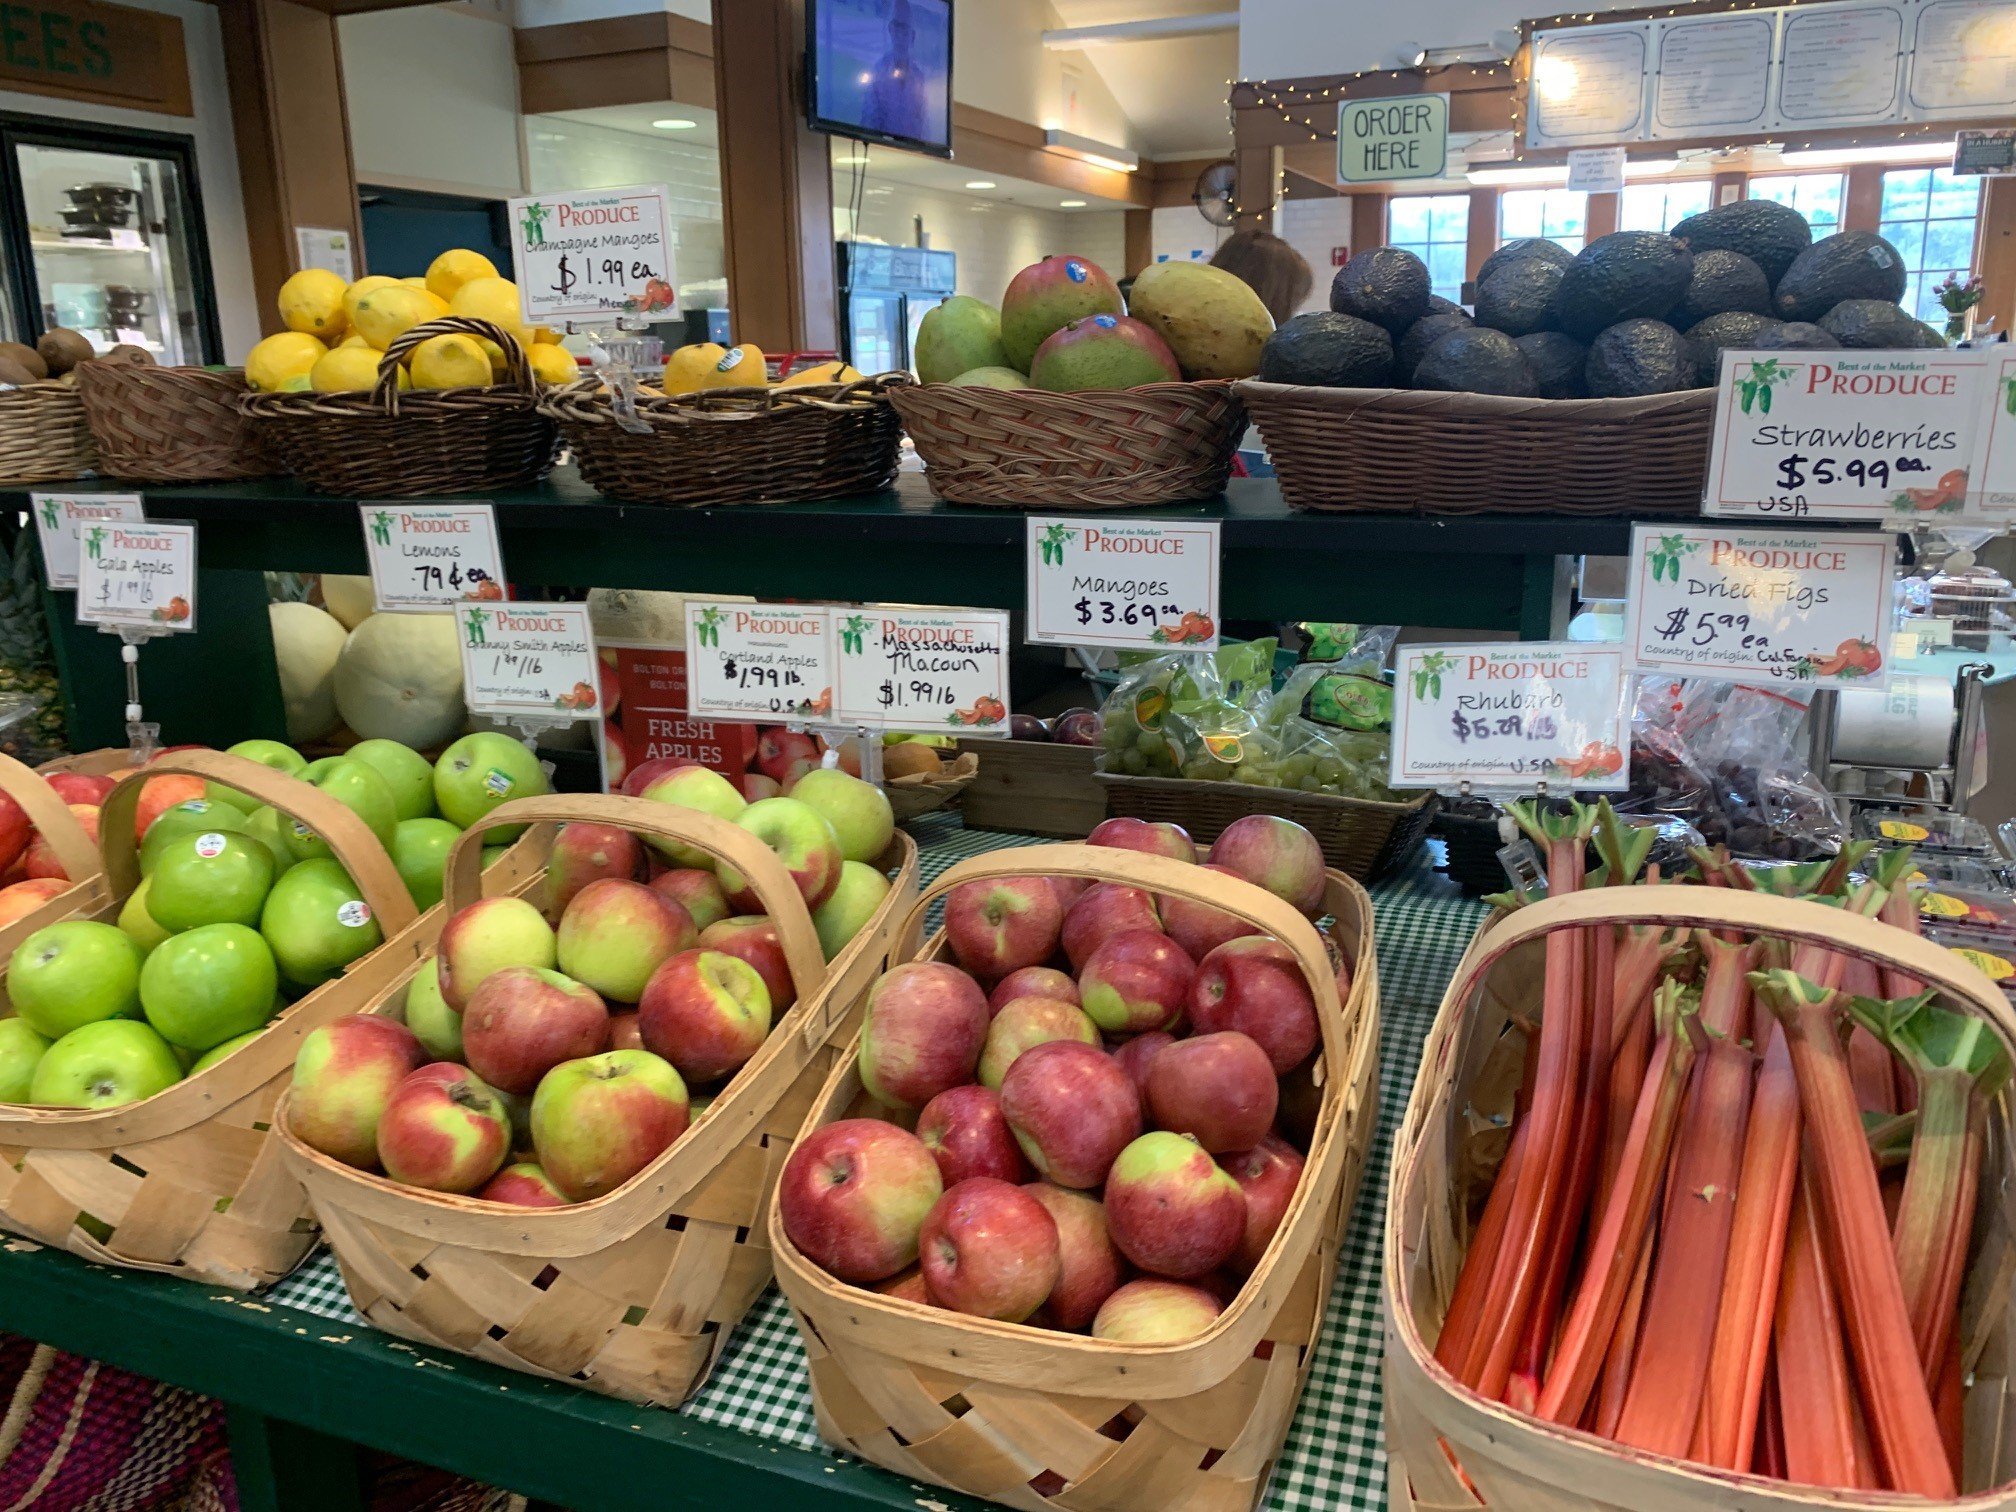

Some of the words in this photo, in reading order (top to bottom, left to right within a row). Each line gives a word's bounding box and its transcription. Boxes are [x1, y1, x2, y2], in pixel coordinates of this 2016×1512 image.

[1354, 104, 1432, 138] ORDER
[1364, 140, 1420, 172] HERE
[558, 204, 640, 227] PRODUCE
[602, 232, 660, 250] Mangoes
[1837, 361, 1860, 371] Best
[1861, 361, 1871, 371] of
[1873, 361, 1886, 371] the
[1888, 361, 1926, 371] Market
[1806, 364, 1957, 395] PRODUCE
[1752, 422, 1957, 450] Strawberries
[1776, 453, 1889, 490] $5.99
[1758, 495, 1809, 516] USA
[401, 513, 471, 533] PRODUCE
[1102, 527, 1117, 536] Best
[1137, 528, 1162, 536] Market
[114, 530, 173, 551] PRODUCE
[402, 543, 462, 558] Lemons
[1084, 529, 1184, 555] PRODUCE
[1737, 537, 1757, 547] Best
[1759, 538, 1767, 548] of
[1769, 539, 1782, 548] the
[1783, 539, 1818, 549] Market
[1710, 540, 1846, 571] PRODUCE
[97, 558, 128, 574] Gala
[133, 559, 174, 579] Apples
[1072, 576, 1170, 601] Mangoes
[1687, 576, 1758, 600] Dried
[1769, 579, 1829, 610] Figs
[496, 611, 566, 632] PRODUCE
[1075, 596, 1157, 626] $3.69
[736, 612, 820, 636] PRODUCE
[882, 619, 974, 644] PRODUCE
[513, 639, 549, 651] Smith
[551, 639, 588, 657] Apples
[1741, 633, 1769, 649] ea
[719, 650, 774, 665] Cortland
[777, 654, 819, 671] Apples
[887, 652, 979, 675] Macoun
[1490, 652, 1508, 660] Best
[1518, 652, 1530, 660] the
[1531, 651, 1562, 660] Market
[1697, 647, 1711, 661] of
[1712, 650, 1753, 665] origin:
[633, 664, 669, 675] BOLTON
[1467, 655, 1589, 681] PRODUCE
[1457, 688, 1563, 710] Rhubarb
[648, 719, 715, 740] FRESH
[646, 742, 722, 763] APPLES
[1458, 758, 1471, 772] of
